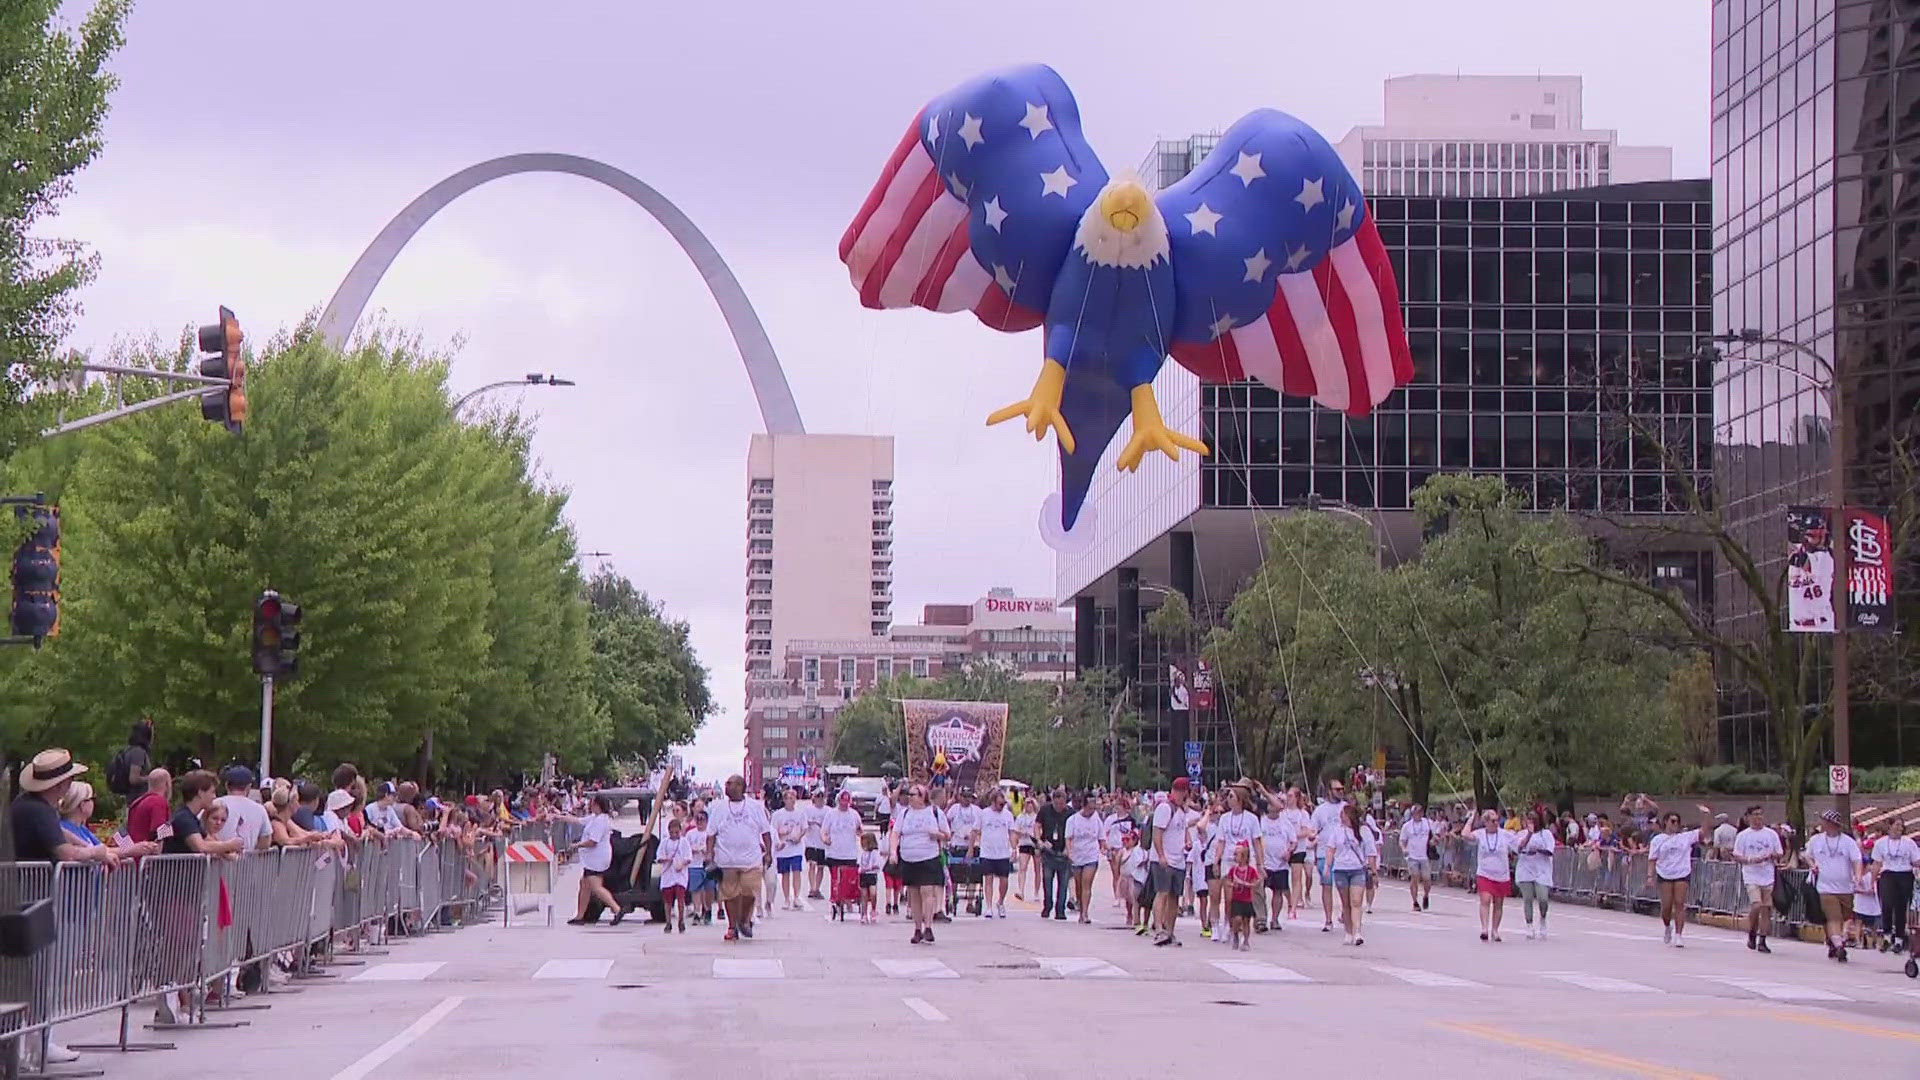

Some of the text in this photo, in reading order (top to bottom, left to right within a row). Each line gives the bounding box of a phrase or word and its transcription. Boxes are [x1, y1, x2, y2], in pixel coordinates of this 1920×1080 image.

[1803, 584, 1823, 600] 46
[985, 599, 1033, 612] DRURY
[1187, 764, 1201, 776] 64
